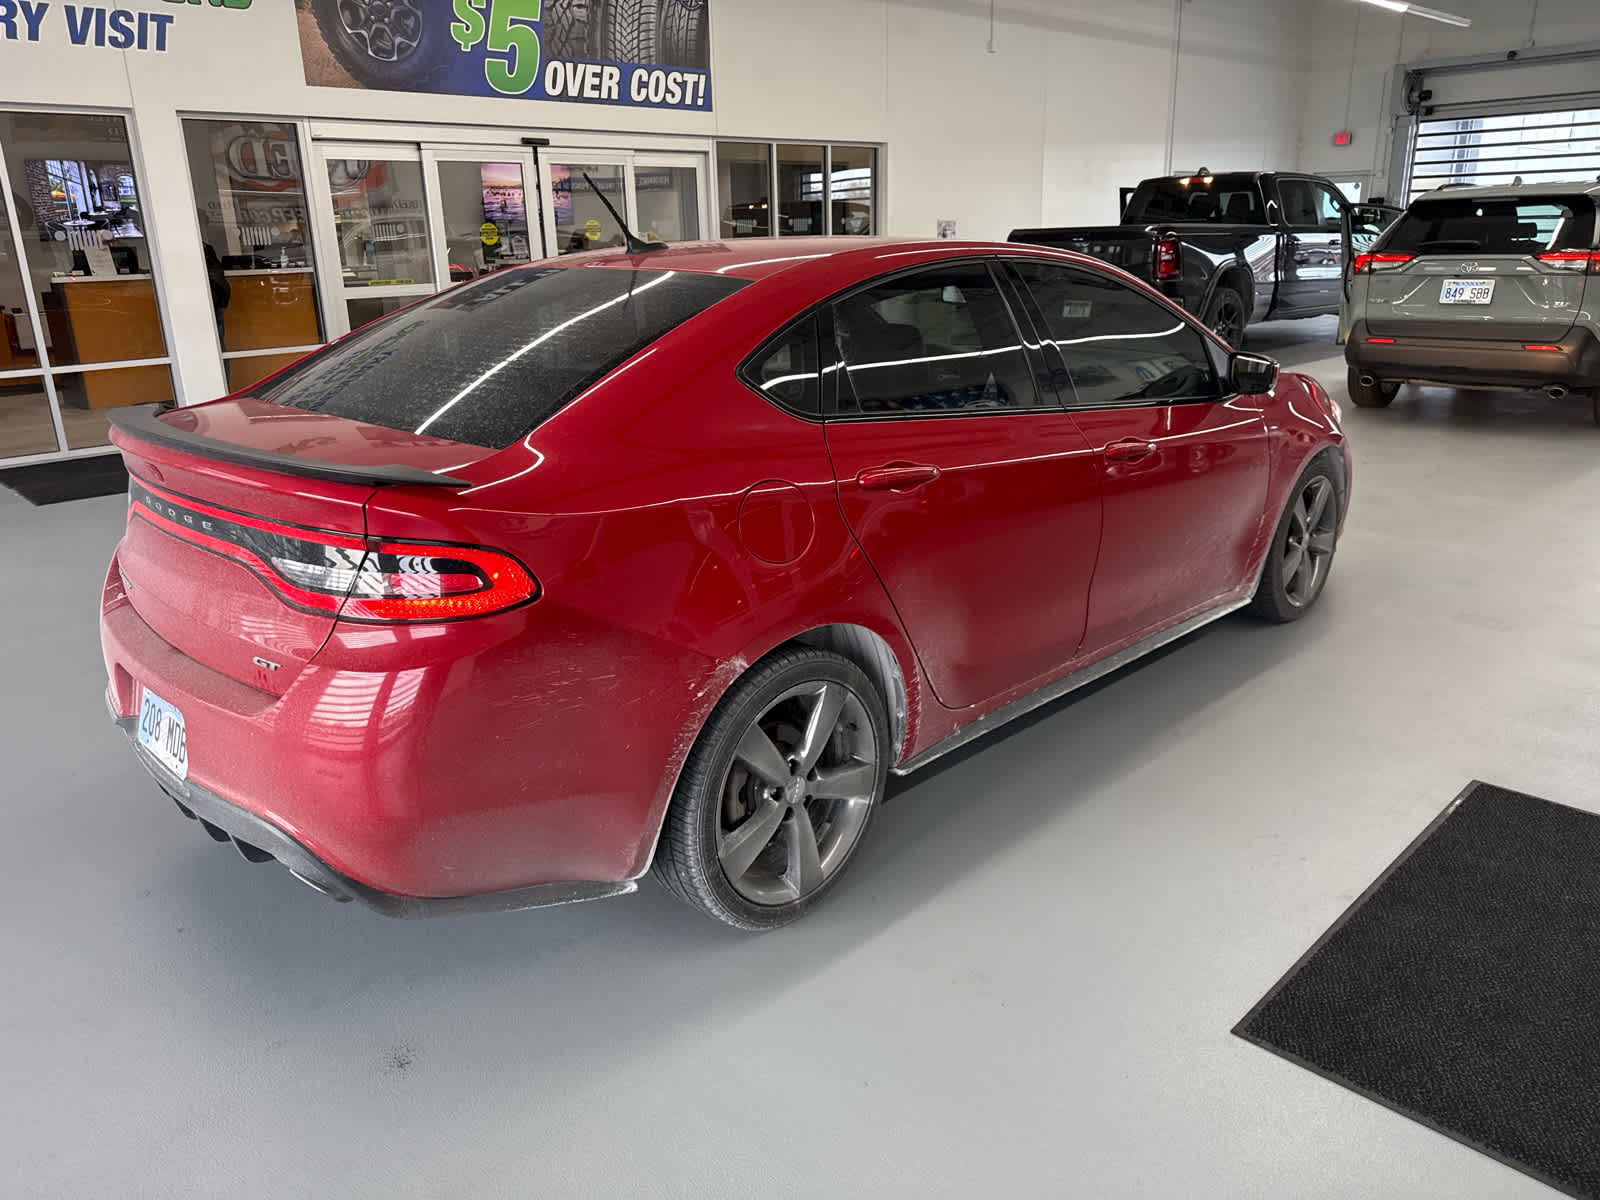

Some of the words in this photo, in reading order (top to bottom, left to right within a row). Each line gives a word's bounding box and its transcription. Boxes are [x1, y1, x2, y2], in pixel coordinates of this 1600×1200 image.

[64, 5, 174, 51] VISIT
[544, 60, 621, 100] OVER
[630, 68, 707, 106] COST!
[1445, 287, 1465, 299] 849
[252, 655, 281, 671] GT
[142, 698, 162, 742] 208
